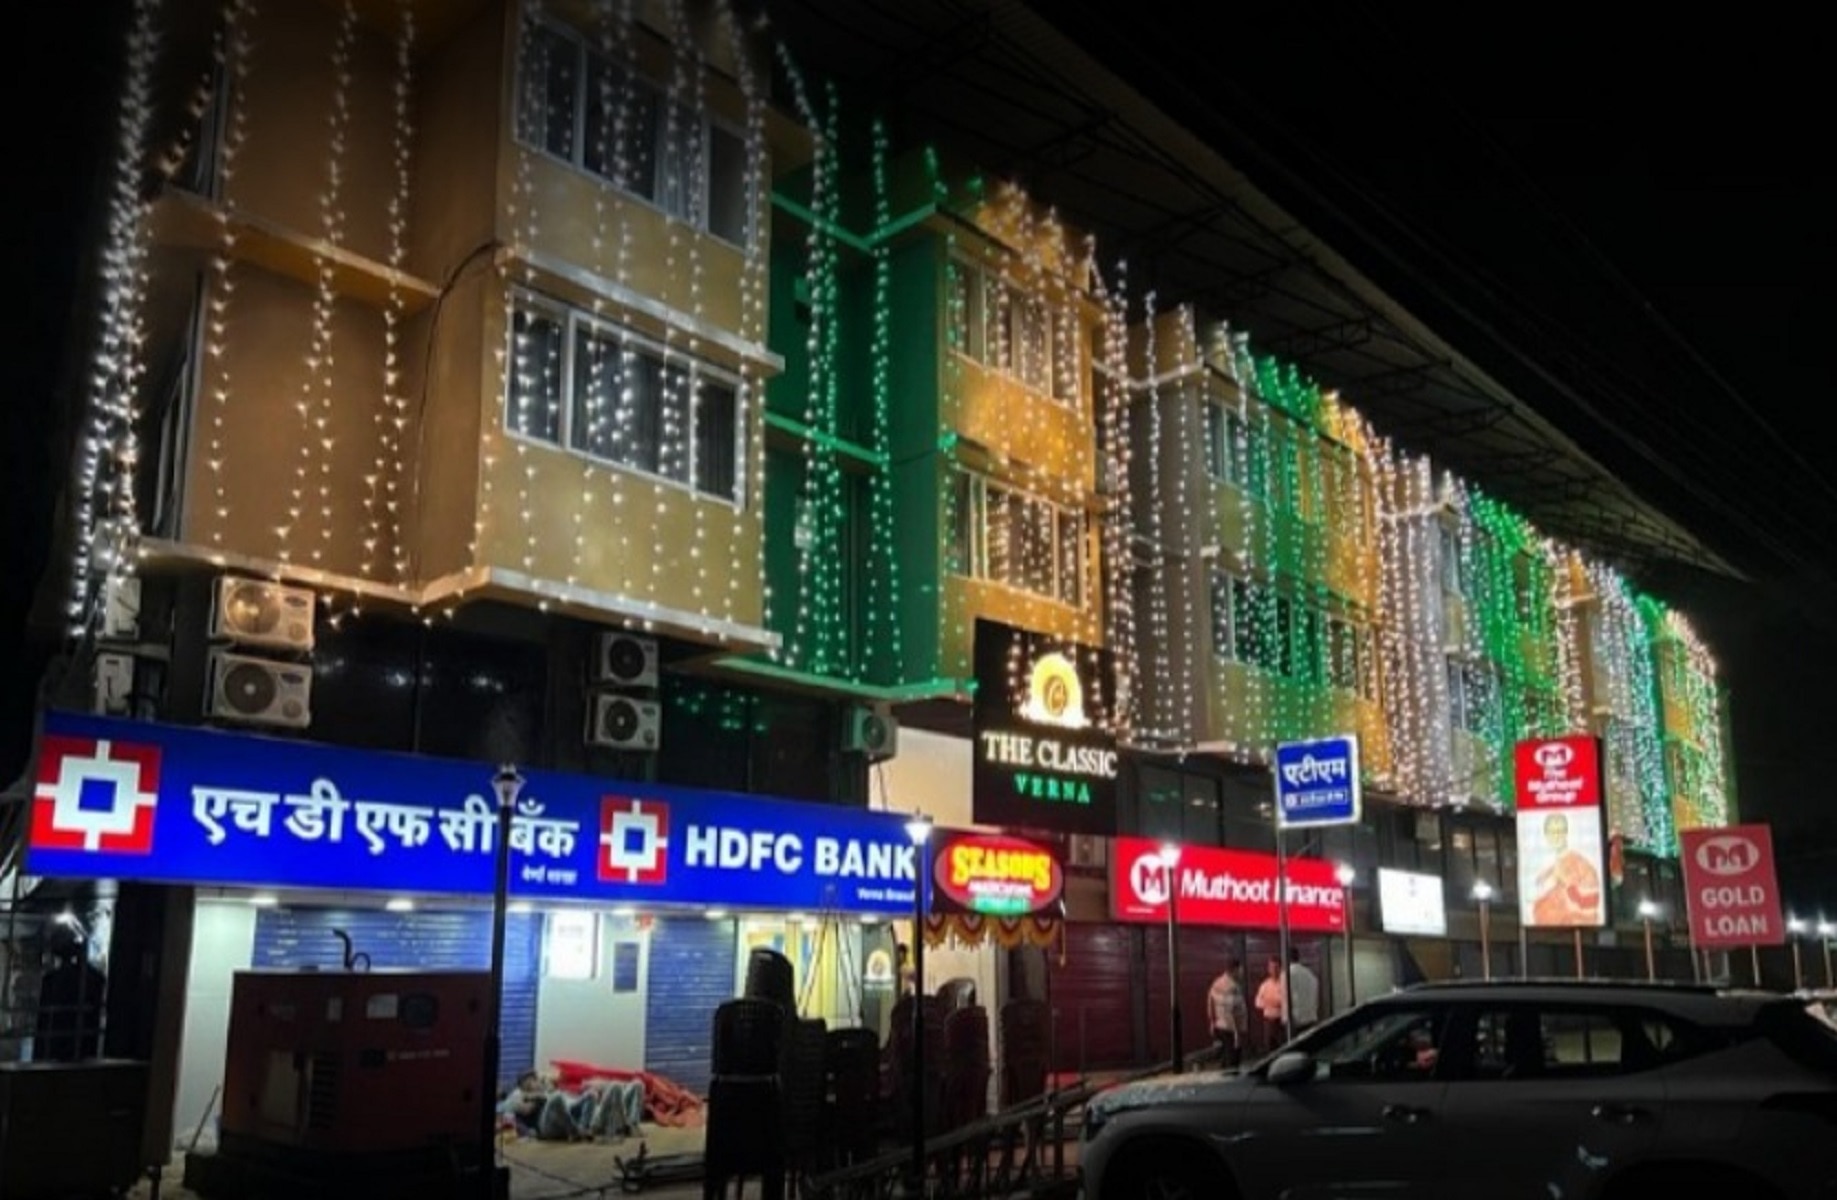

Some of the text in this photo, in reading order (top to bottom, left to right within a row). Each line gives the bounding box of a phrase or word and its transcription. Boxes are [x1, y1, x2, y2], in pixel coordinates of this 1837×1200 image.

[981, 731, 1118, 778] THE CLASSIC
[1284, 755, 1346, 788] एटीएम
[1014, 774, 1091, 803] VERNA
[191, 786, 279, 844] एच
[284, 778, 350, 841] डी
[355, 802, 432, 854] एफ
[438, 795, 497, 852] सी
[687, 826, 916, 881] HDFC BANK
[1181, 868, 1269, 904] Muthoot
[1701, 886, 1765, 907] GOLD
[1704, 916, 1768, 937] LOAN
